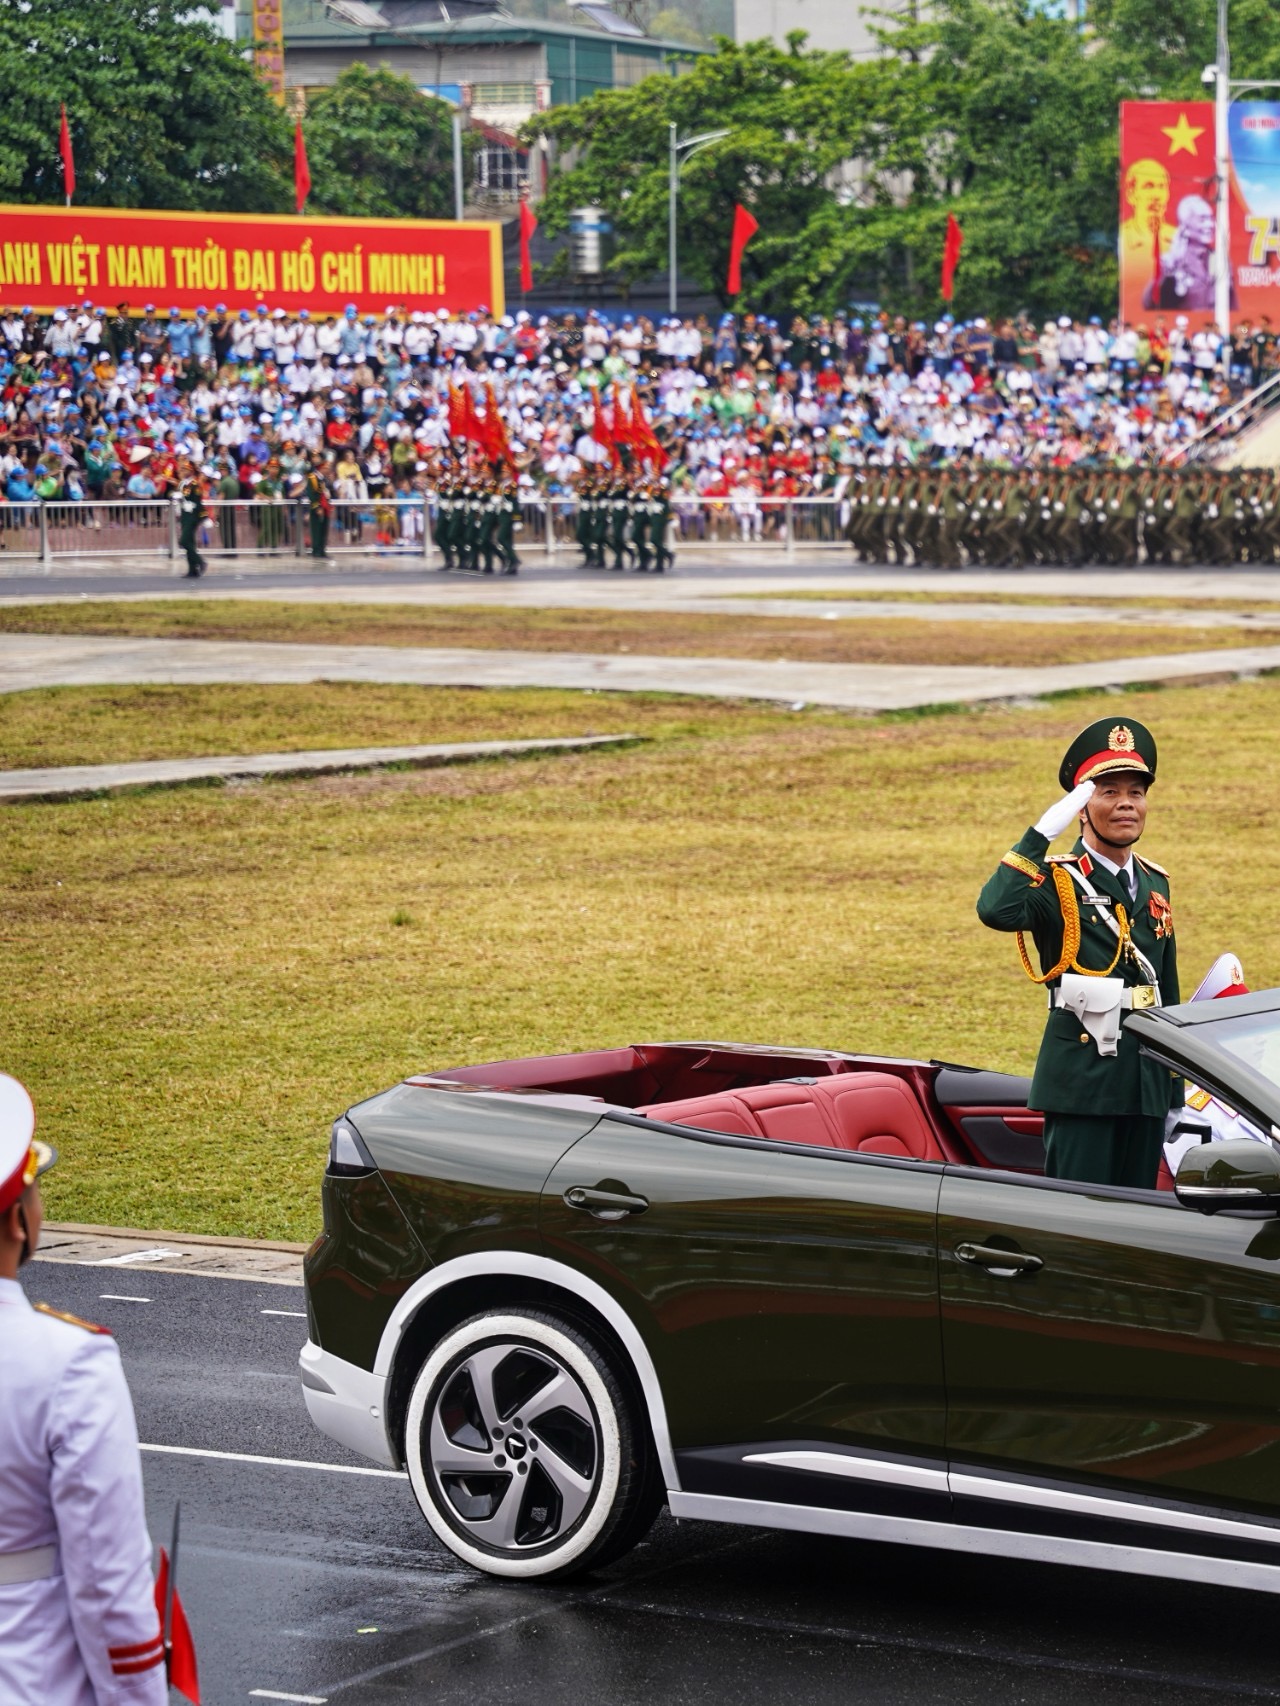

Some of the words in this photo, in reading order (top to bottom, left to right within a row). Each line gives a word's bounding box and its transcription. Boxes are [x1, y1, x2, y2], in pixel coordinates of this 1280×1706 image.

[46, 234, 100, 295] VIỆT
[107, 245, 166, 288] NAM
[171, 238, 227, 290] THỜI
[233, 249, 275, 300] ĐẠI
[281, 237, 316, 292] HỒ
[321, 244, 363, 293] CHÍ
[368, 253, 446, 295] MINH!
